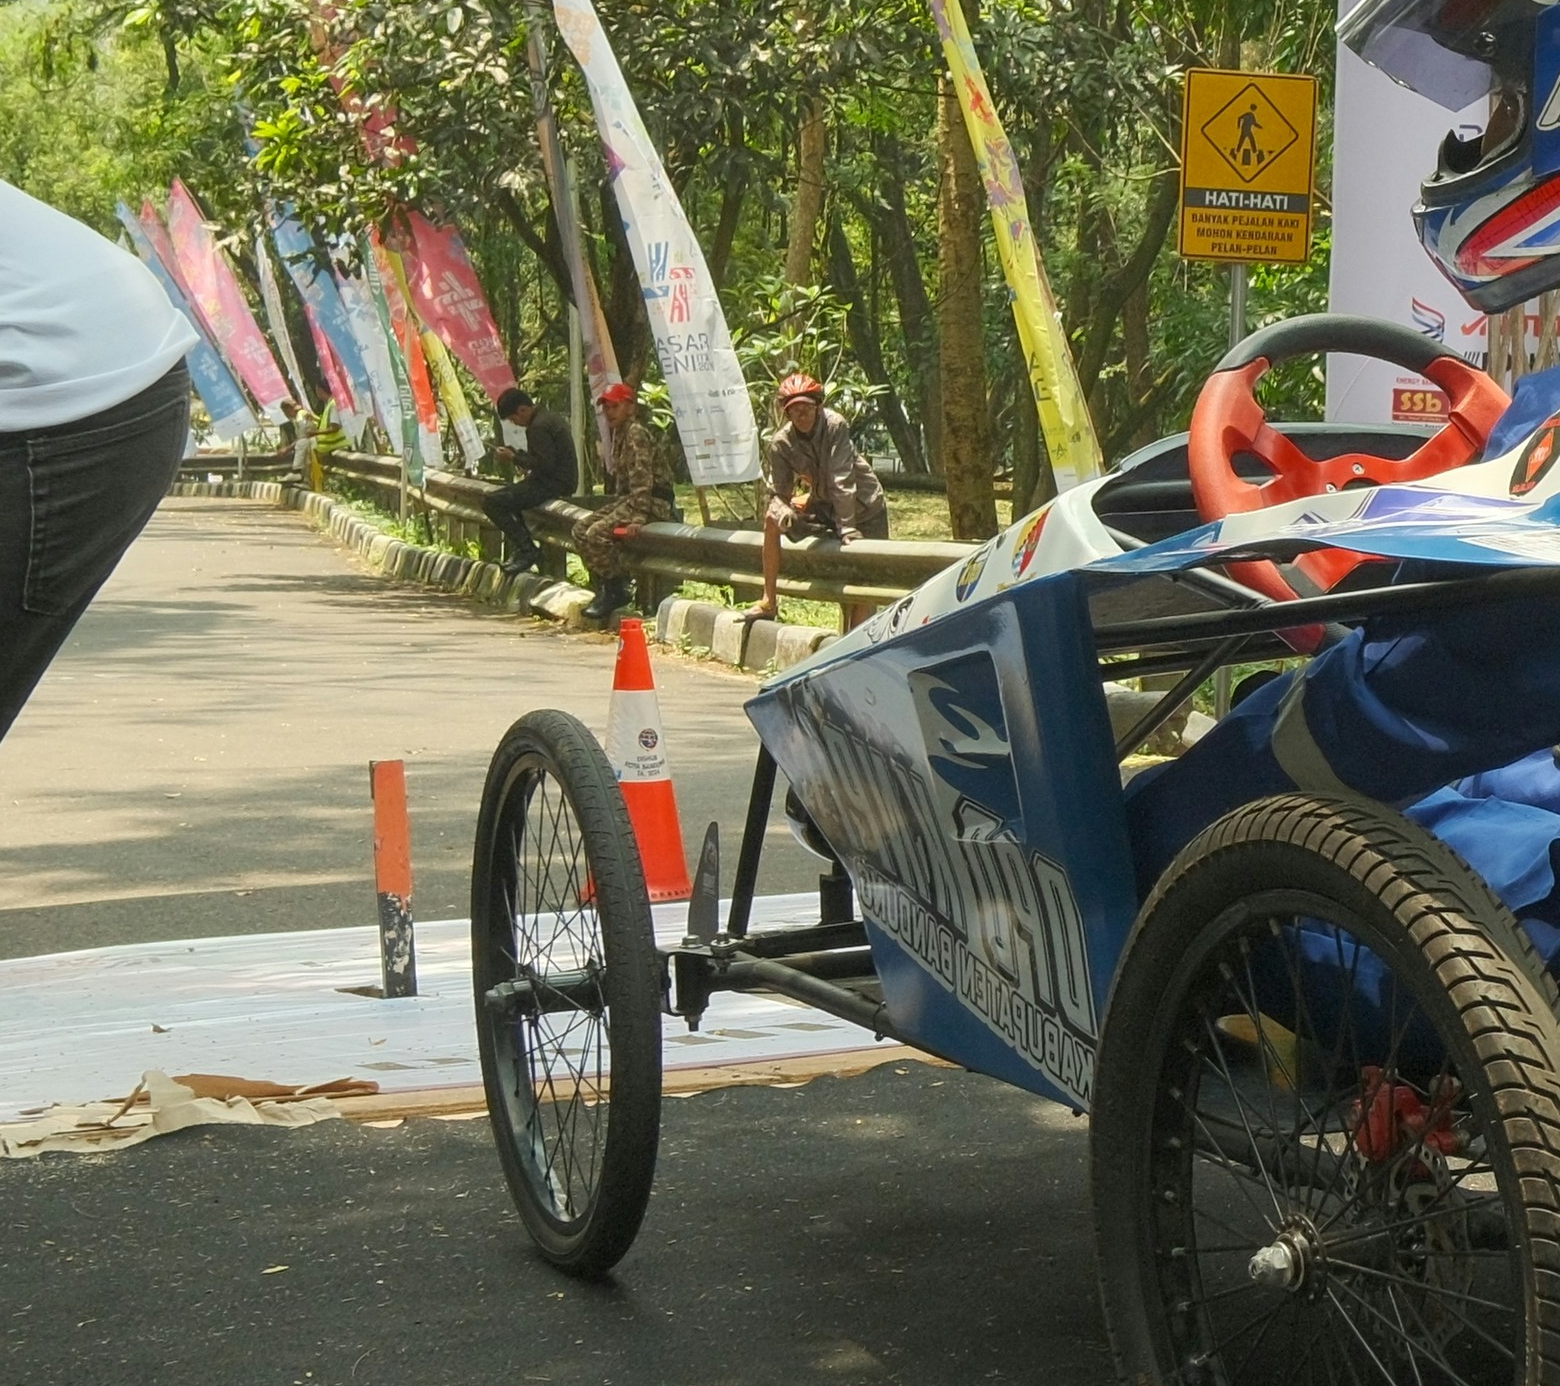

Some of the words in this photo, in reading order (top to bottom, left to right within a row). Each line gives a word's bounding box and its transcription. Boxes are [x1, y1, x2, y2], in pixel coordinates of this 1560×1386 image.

[1204, 190, 1289, 211] HATI-HATI
[1191, 213, 1230, 226] BANYAK
[1232, 215, 1274, 228] PEJALAN
[1277, 217, 1300, 229] KAKI
[1196, 226, 1233, 239] MOHON
[1235, 229, 1294, 243] KENDARAAN
[1211, 241, 1278, 256] PELAN-PELAN
[655, 332, 711, 355] ASAR
[663, 354, 697, 376] ENI
[1400, 391, 1442, 413] SSb
